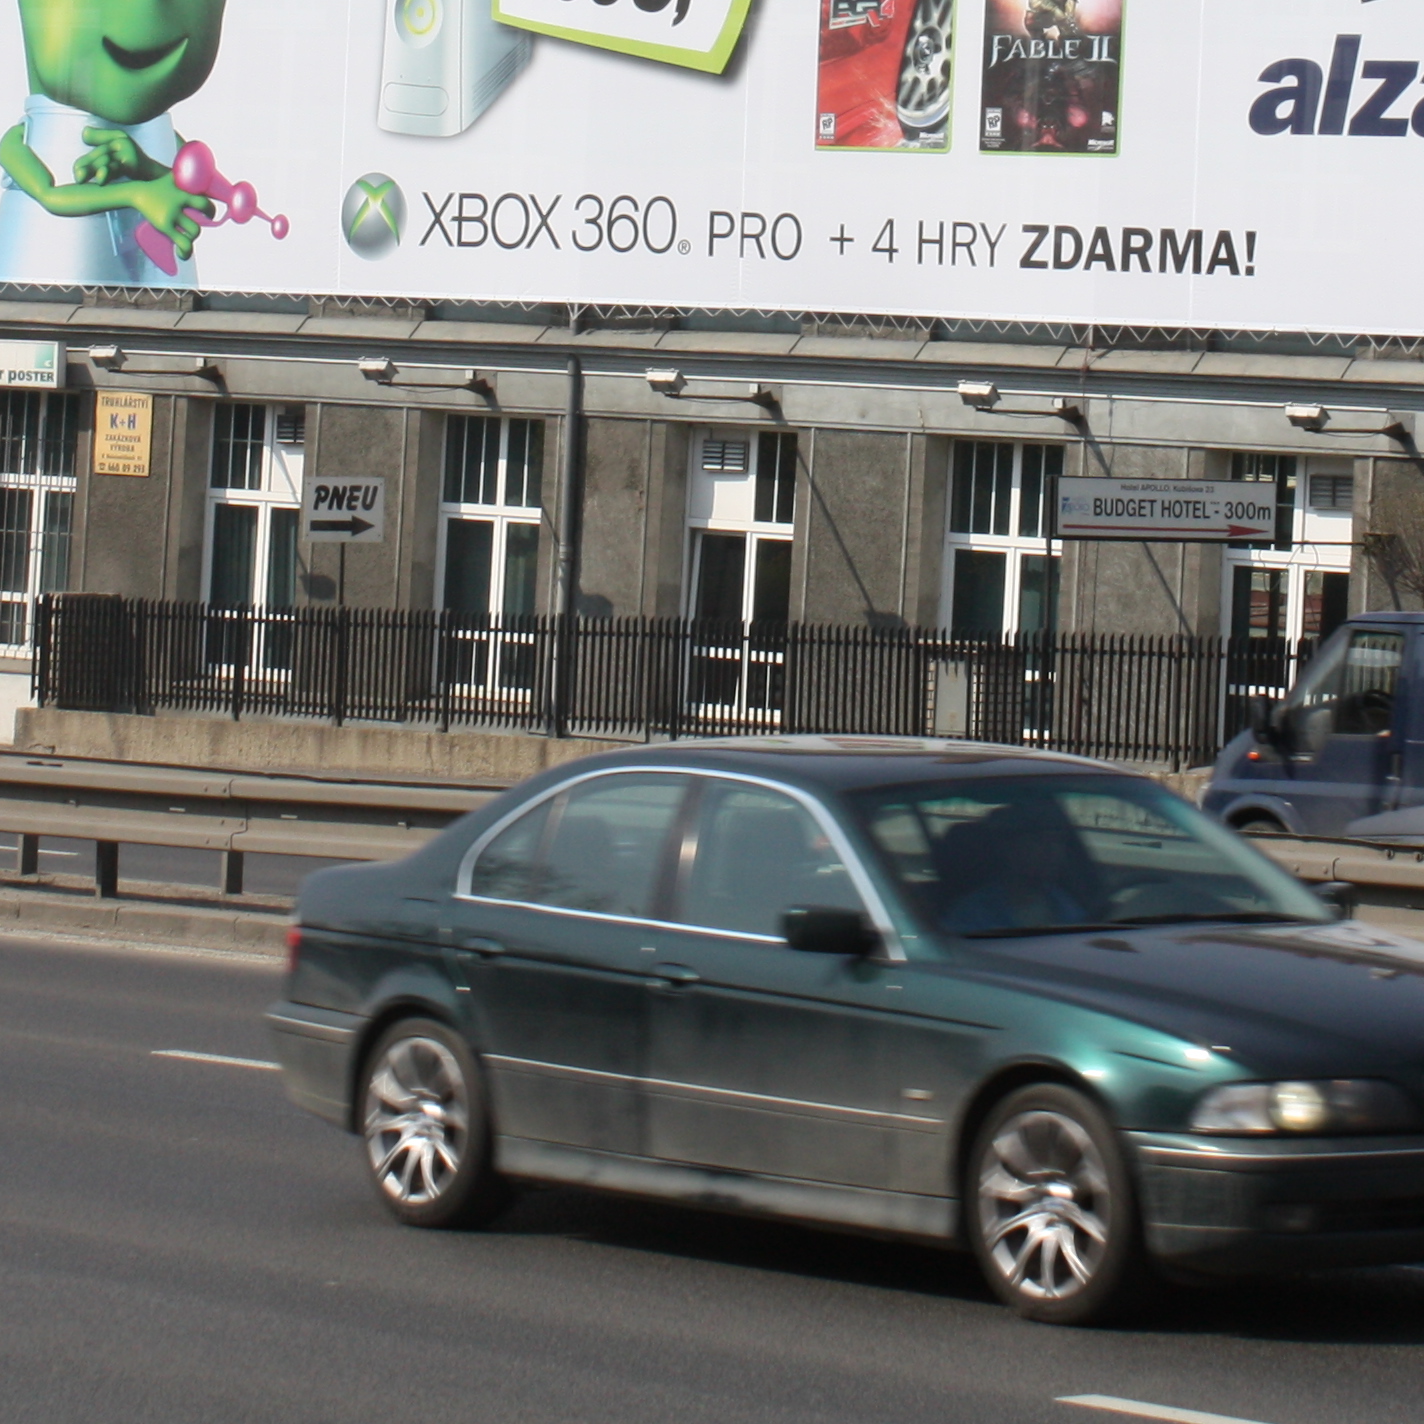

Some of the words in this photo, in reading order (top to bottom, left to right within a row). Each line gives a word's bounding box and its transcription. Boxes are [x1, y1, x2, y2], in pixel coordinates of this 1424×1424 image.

[988, 35, 1082, 69] FABLE
[1084, 35, 1118, 65] II
[419, 192, 562, 250] XBOX
[708, 211, 803, 261] PRO
[871, 218, 899, 263] 4
[917, 220, 1007, 268] HRY
[1019, 223, 1257, 276] ZDARMA!
[313, 484, 378, 511] PNEU
[1093, 497, 1157, 518] BUDGET
[1161, 499, 1211, 519] HOTEL
[1224, 501, 1271, 521] 300m
